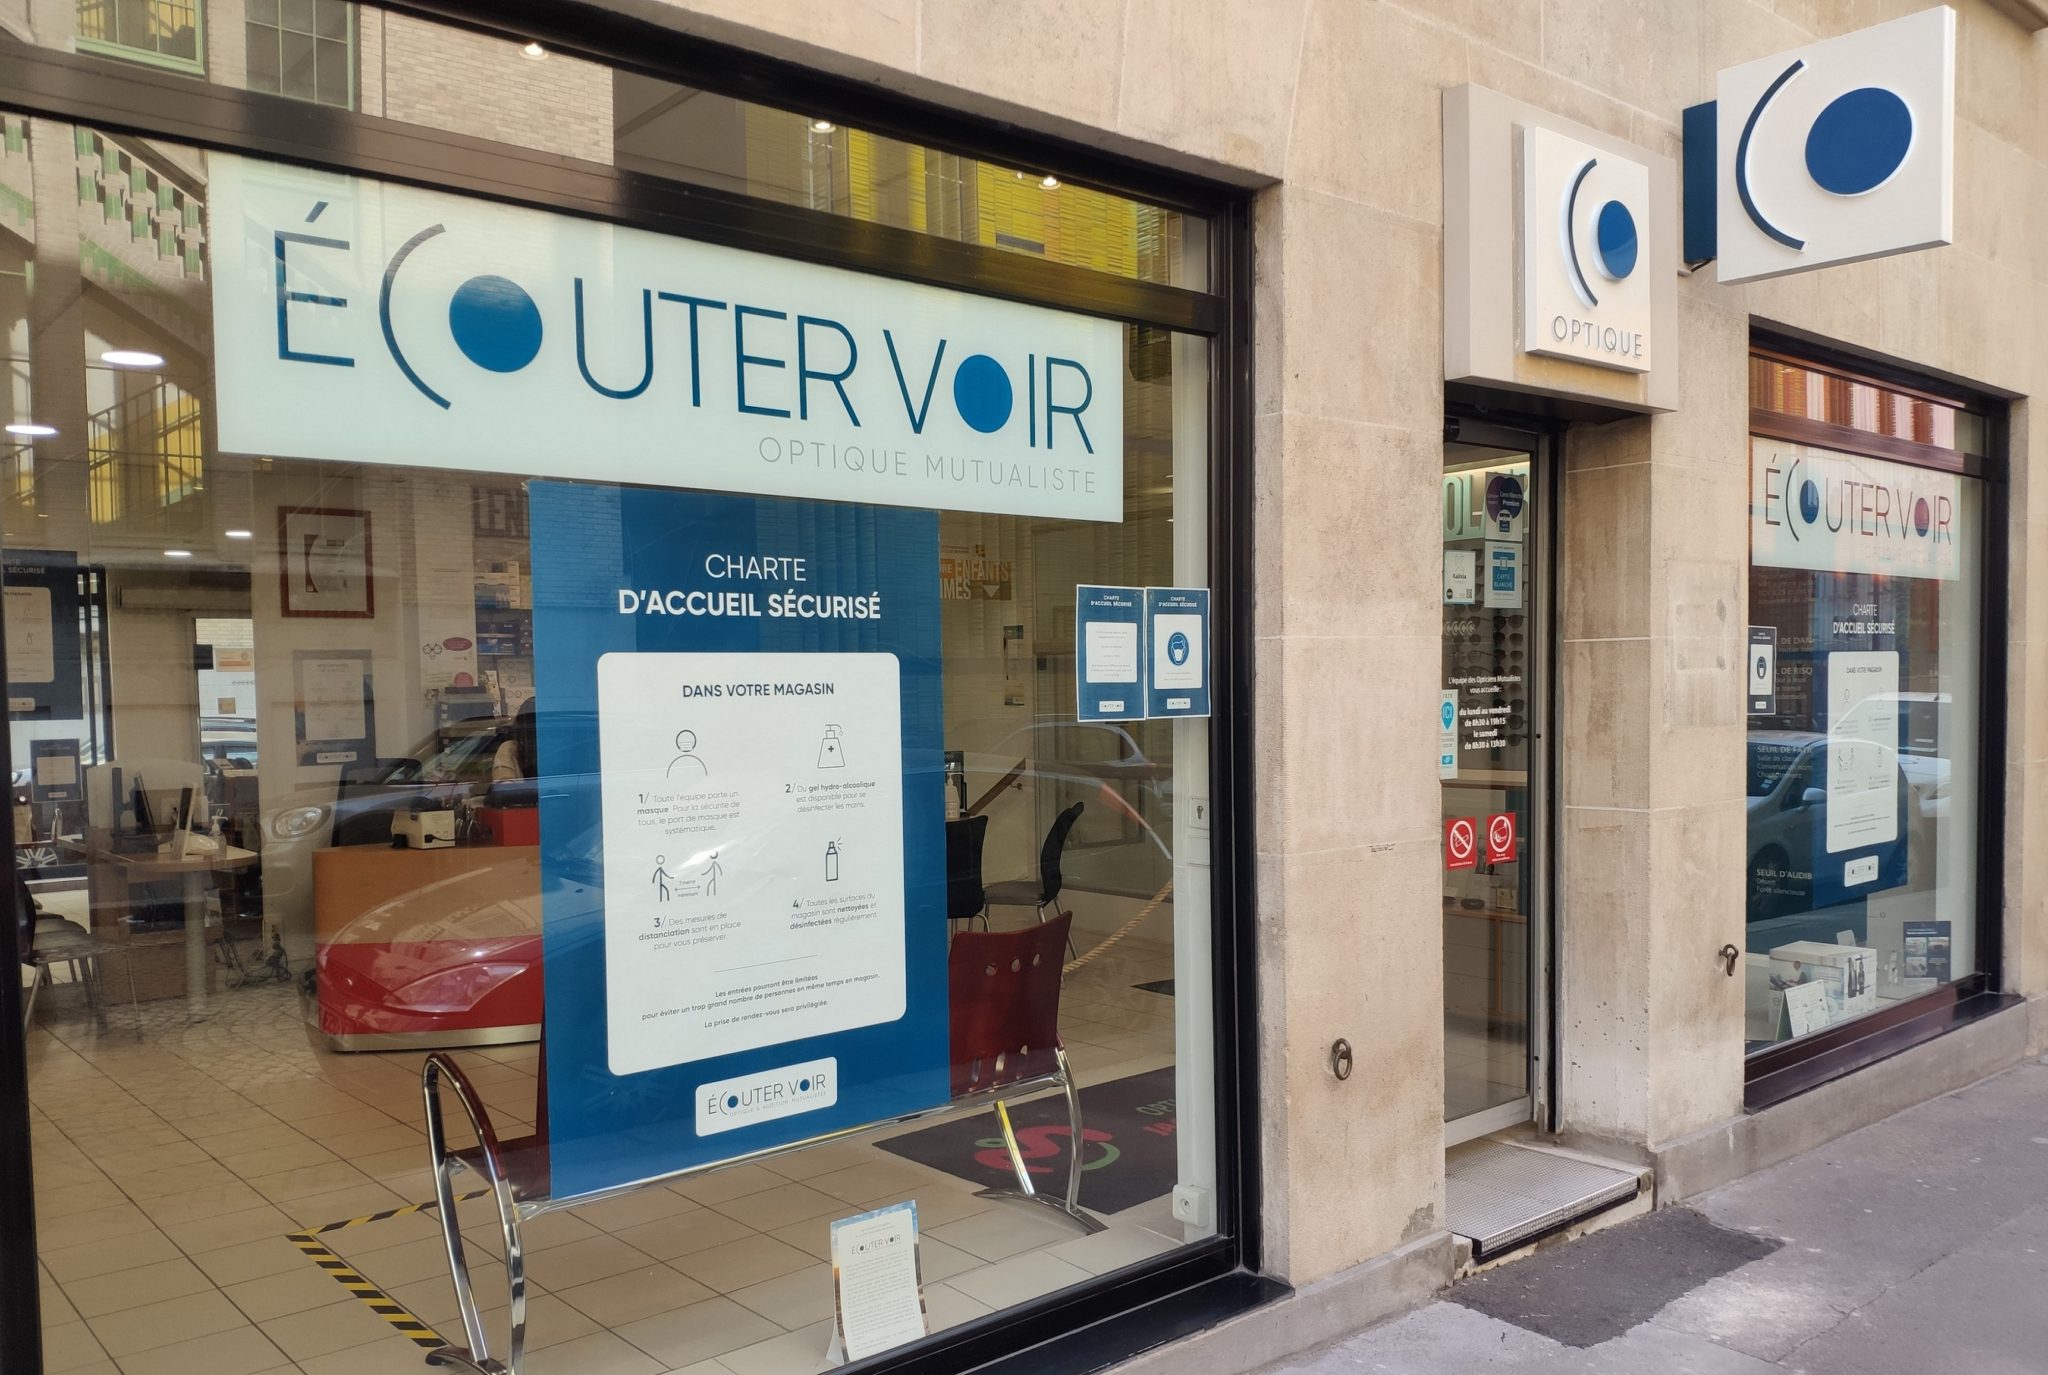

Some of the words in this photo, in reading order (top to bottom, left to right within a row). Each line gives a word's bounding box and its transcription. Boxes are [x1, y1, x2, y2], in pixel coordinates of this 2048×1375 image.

[274, 200, 861, 428] ÉCOUTER
[882, 327, 1095, 455] VOIR
[1553, 315, 1643, 358] OPTIQUE
[759, 435, 908, 478] OPTIQUE
[924, 454, 1098, 495] MUTUALISTE
[1765, 453, 1891, 542] ÉCOUTER
[1896, 488, 1952, 545] VOIR
[705, 554, 806, 581] CHARTE
[955, 559, 1009, 581] ENFANTS
[940, 577, 972, 600] MES
[618, 589, 761, 617] D'ACCUEIL
[768, 588, 881, 619] SÉCURISÉ
[1853, 603, 1878, 617] CHARTE
[1833, 621, 1865, 634] D'ACCUEIL
[1867, 619, 1895, 634] SÉCURISÉ
[1448, 676, 1467, 685] L'équipe
[1468, 675, 1476, 684] des
[1476, 675, 1496, 684] Opticiens
[682, 684, 722, 697] DANS
[726, 684, 770, 697] VOTRE
[774, 682, 834, 696] MAGASIN
[1459, 708, 1466, 716] du
[1467, 706, 1481, 716] lundi
[1488, 705, 1511, 714] vendredi
[1473, 730, 1478, 738] le
[1478, 729, 1498, 737] samedi
[1465, 742, 1472, 750] de
[808, 784, 820, 793] gel
[820, 781, 876, 792] hydro-alcoolique
[654, 794, 674, 803] Toute
[676, 793, 706, 803] l'équipe
[708, 792, 728, 801] porte
[808, 792, 842, 802] disponible
[672, 804, 690, 812] Pour
[700, 801, 729, 810] sécurité
[797, 804, 834, 813] désinfecter
[834, 802, 844, 810] les
[659, 816, 666, 824] le
[668, 816, 684, 825] port
[698, 812, 728, 822] masque
[1756, 868, 1777, 878] SEUIL
[840, 894, 866, 903] surfaces
[792, 910, 820, 920] magasin
[837, 903, 869, 913] nettoyées
[668, 918, 684, 926] Des
[684, 914, 716, 924] mesures
[790, 918, 832, 930] désinfectées
[638, 928, 690, 941] distanciation
[690, 926, 708, 934] sont
[720, 921, 742, 931] place
[654, 941, 672, 951] pour
[674, 938, 691, 947] vous
[728, 986, 752, 996] entrées
[753, 983, 781, 993] pourront
[781, 978, 794, 987] être
[794, 974, 819, 984] limitées
[642, 1012, 659, 1021] pour
[660, 1008, 680, 1017] éviter
[681, 1006, 691, 1014] un
[691, 1004, 706, 1013] trop
[707, 1000, 728, 1010] grand
[728, 996, 754, 1005] nombre
[764, 988, 796, 1000] personnes
[806, 982, 825, 991] même
[825, 980, 845, 990] temps
[853, 972, 880, 985] magasin.
[704, 1020, 713, 1028] La
[714, 1018, 730, 1027] prise
[731, 1015, 740, 1023] de
[740, 1008, 780, 1021] rendez-vous
[781, 1006, 795, 1014] sera
[796, 1000, 829, 1012] privilégiée.
[708, 1083, 784, 1116] ÉCOUTER
[788, 1073, 826, 1096] VOIR
[729, 1107, 754, 1118] OPTIQUE
[884, 1233, 901, 1245] VOIR
